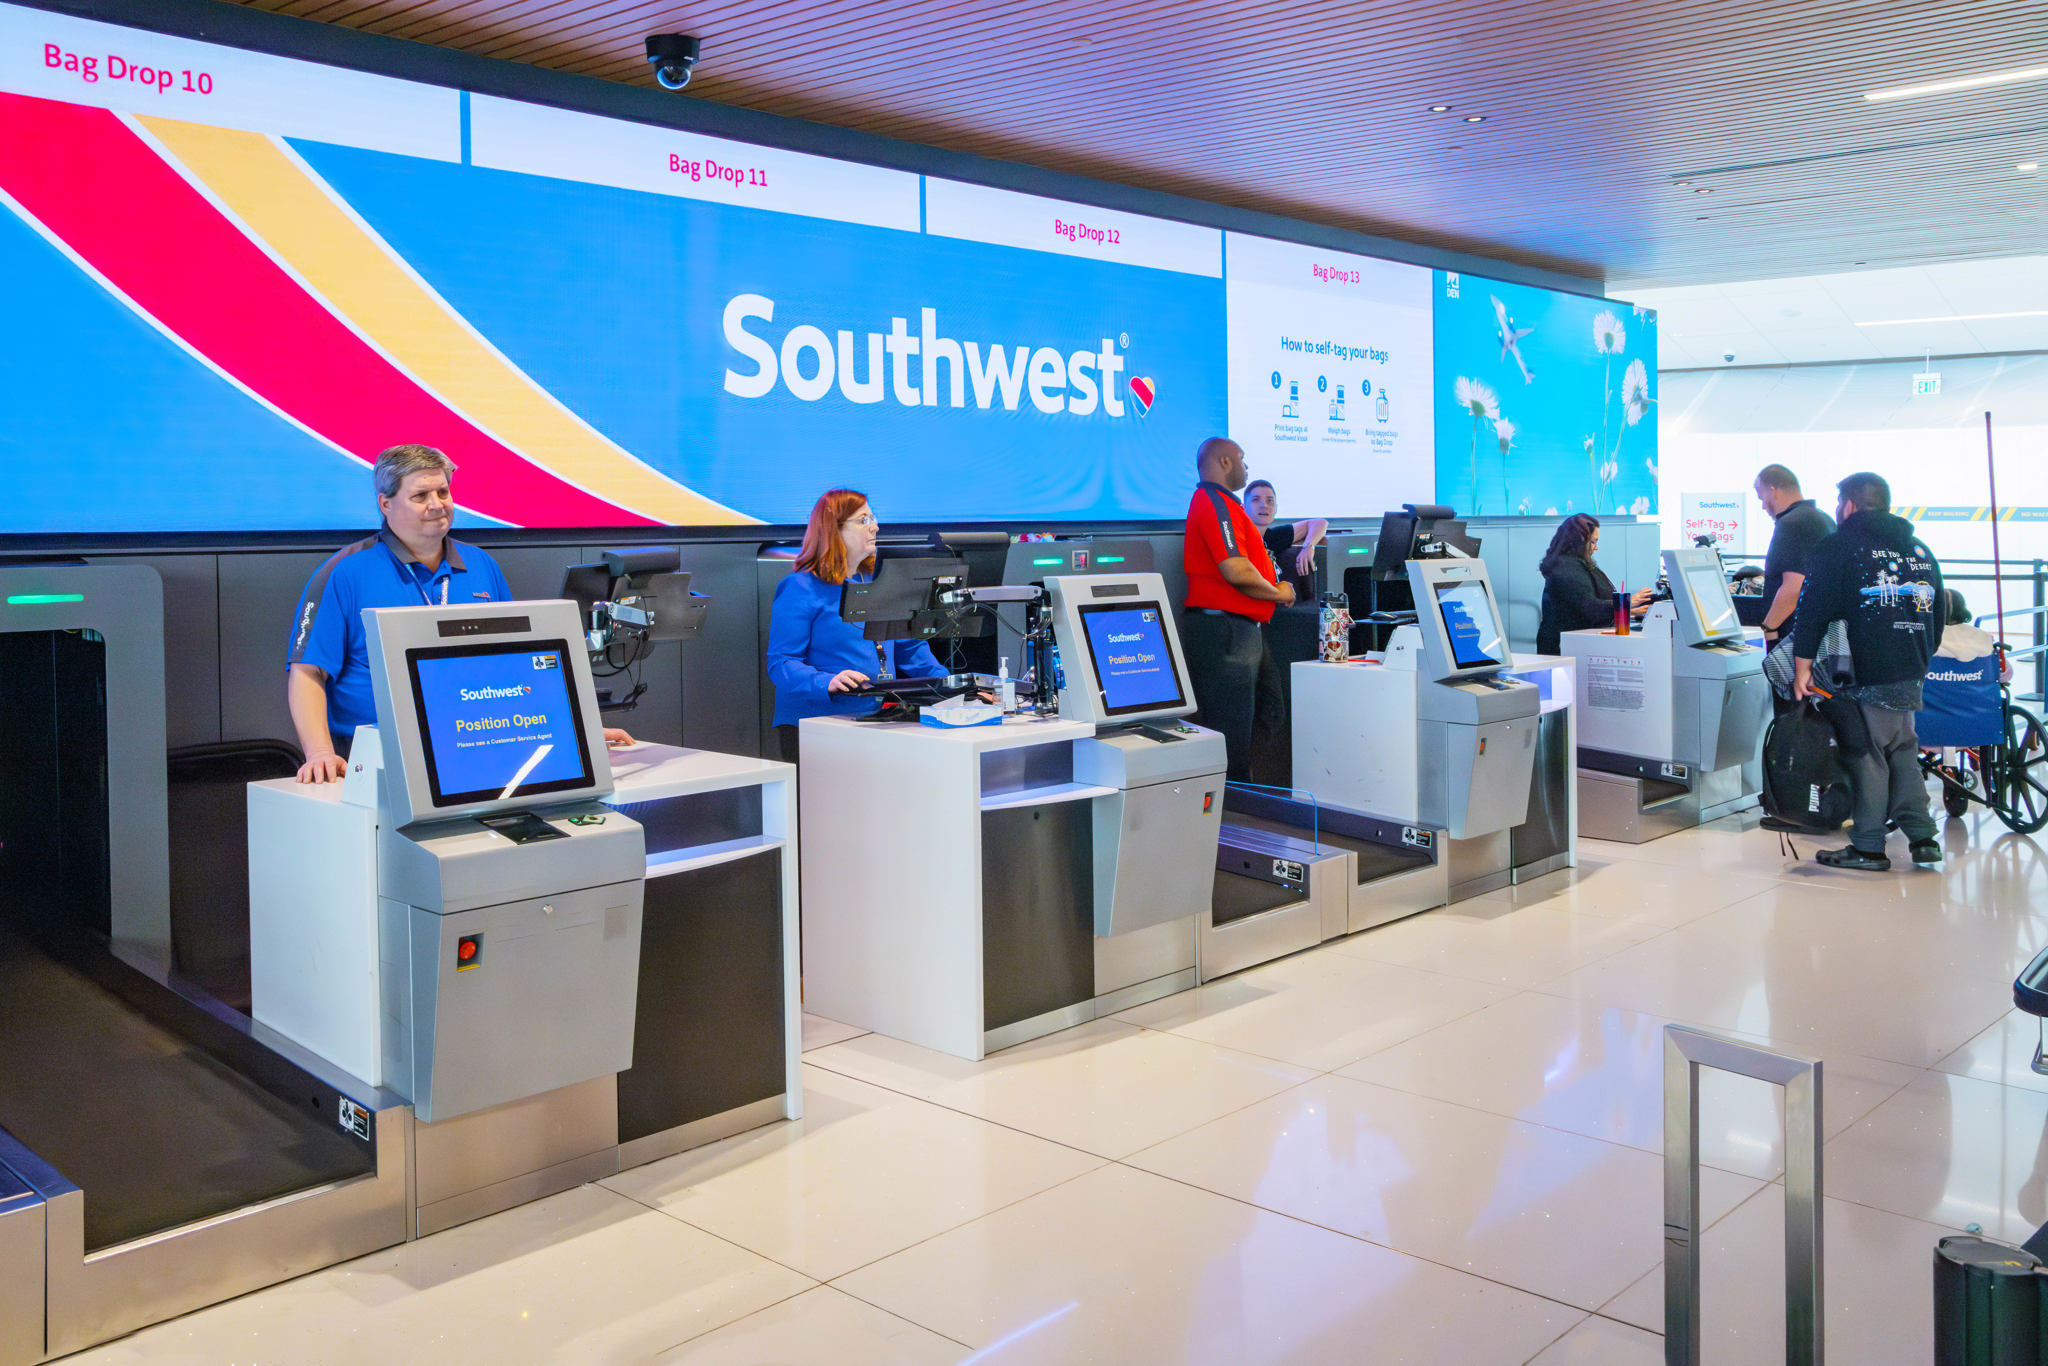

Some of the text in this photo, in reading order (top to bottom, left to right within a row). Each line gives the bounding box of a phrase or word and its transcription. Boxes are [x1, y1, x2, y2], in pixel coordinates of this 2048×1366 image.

[44, 43, 213, 94] Bag Drop 10
[669, 153, 768, 188] Bag Drop 11
[1055, 218, 1120, 246] Bag Drop 12
[1313, 263, 1360, 285] Bag Drop 13
[722, 293, 1125, 418] Southwest
[1281, 336, 1389, 365] How to self-tag your bags
[1918, 380, 1936, 393] EXIT
[1699, 500, 1736, 509] Southwest
[1686, 519, 1725, 531] Self-Tag
[1872, 550, 1900, 559] SEE YOU
[1107, 632, 1141, 643] Southwest
[1108, 653, 1156, 665] Position Open
[1925, 670, 1983, 682] outhwest
[460, 685, 524, 701] Southwest
[456, 714, 547, 732] Position Open
[1809, 783, 1820, 812] PUMA
